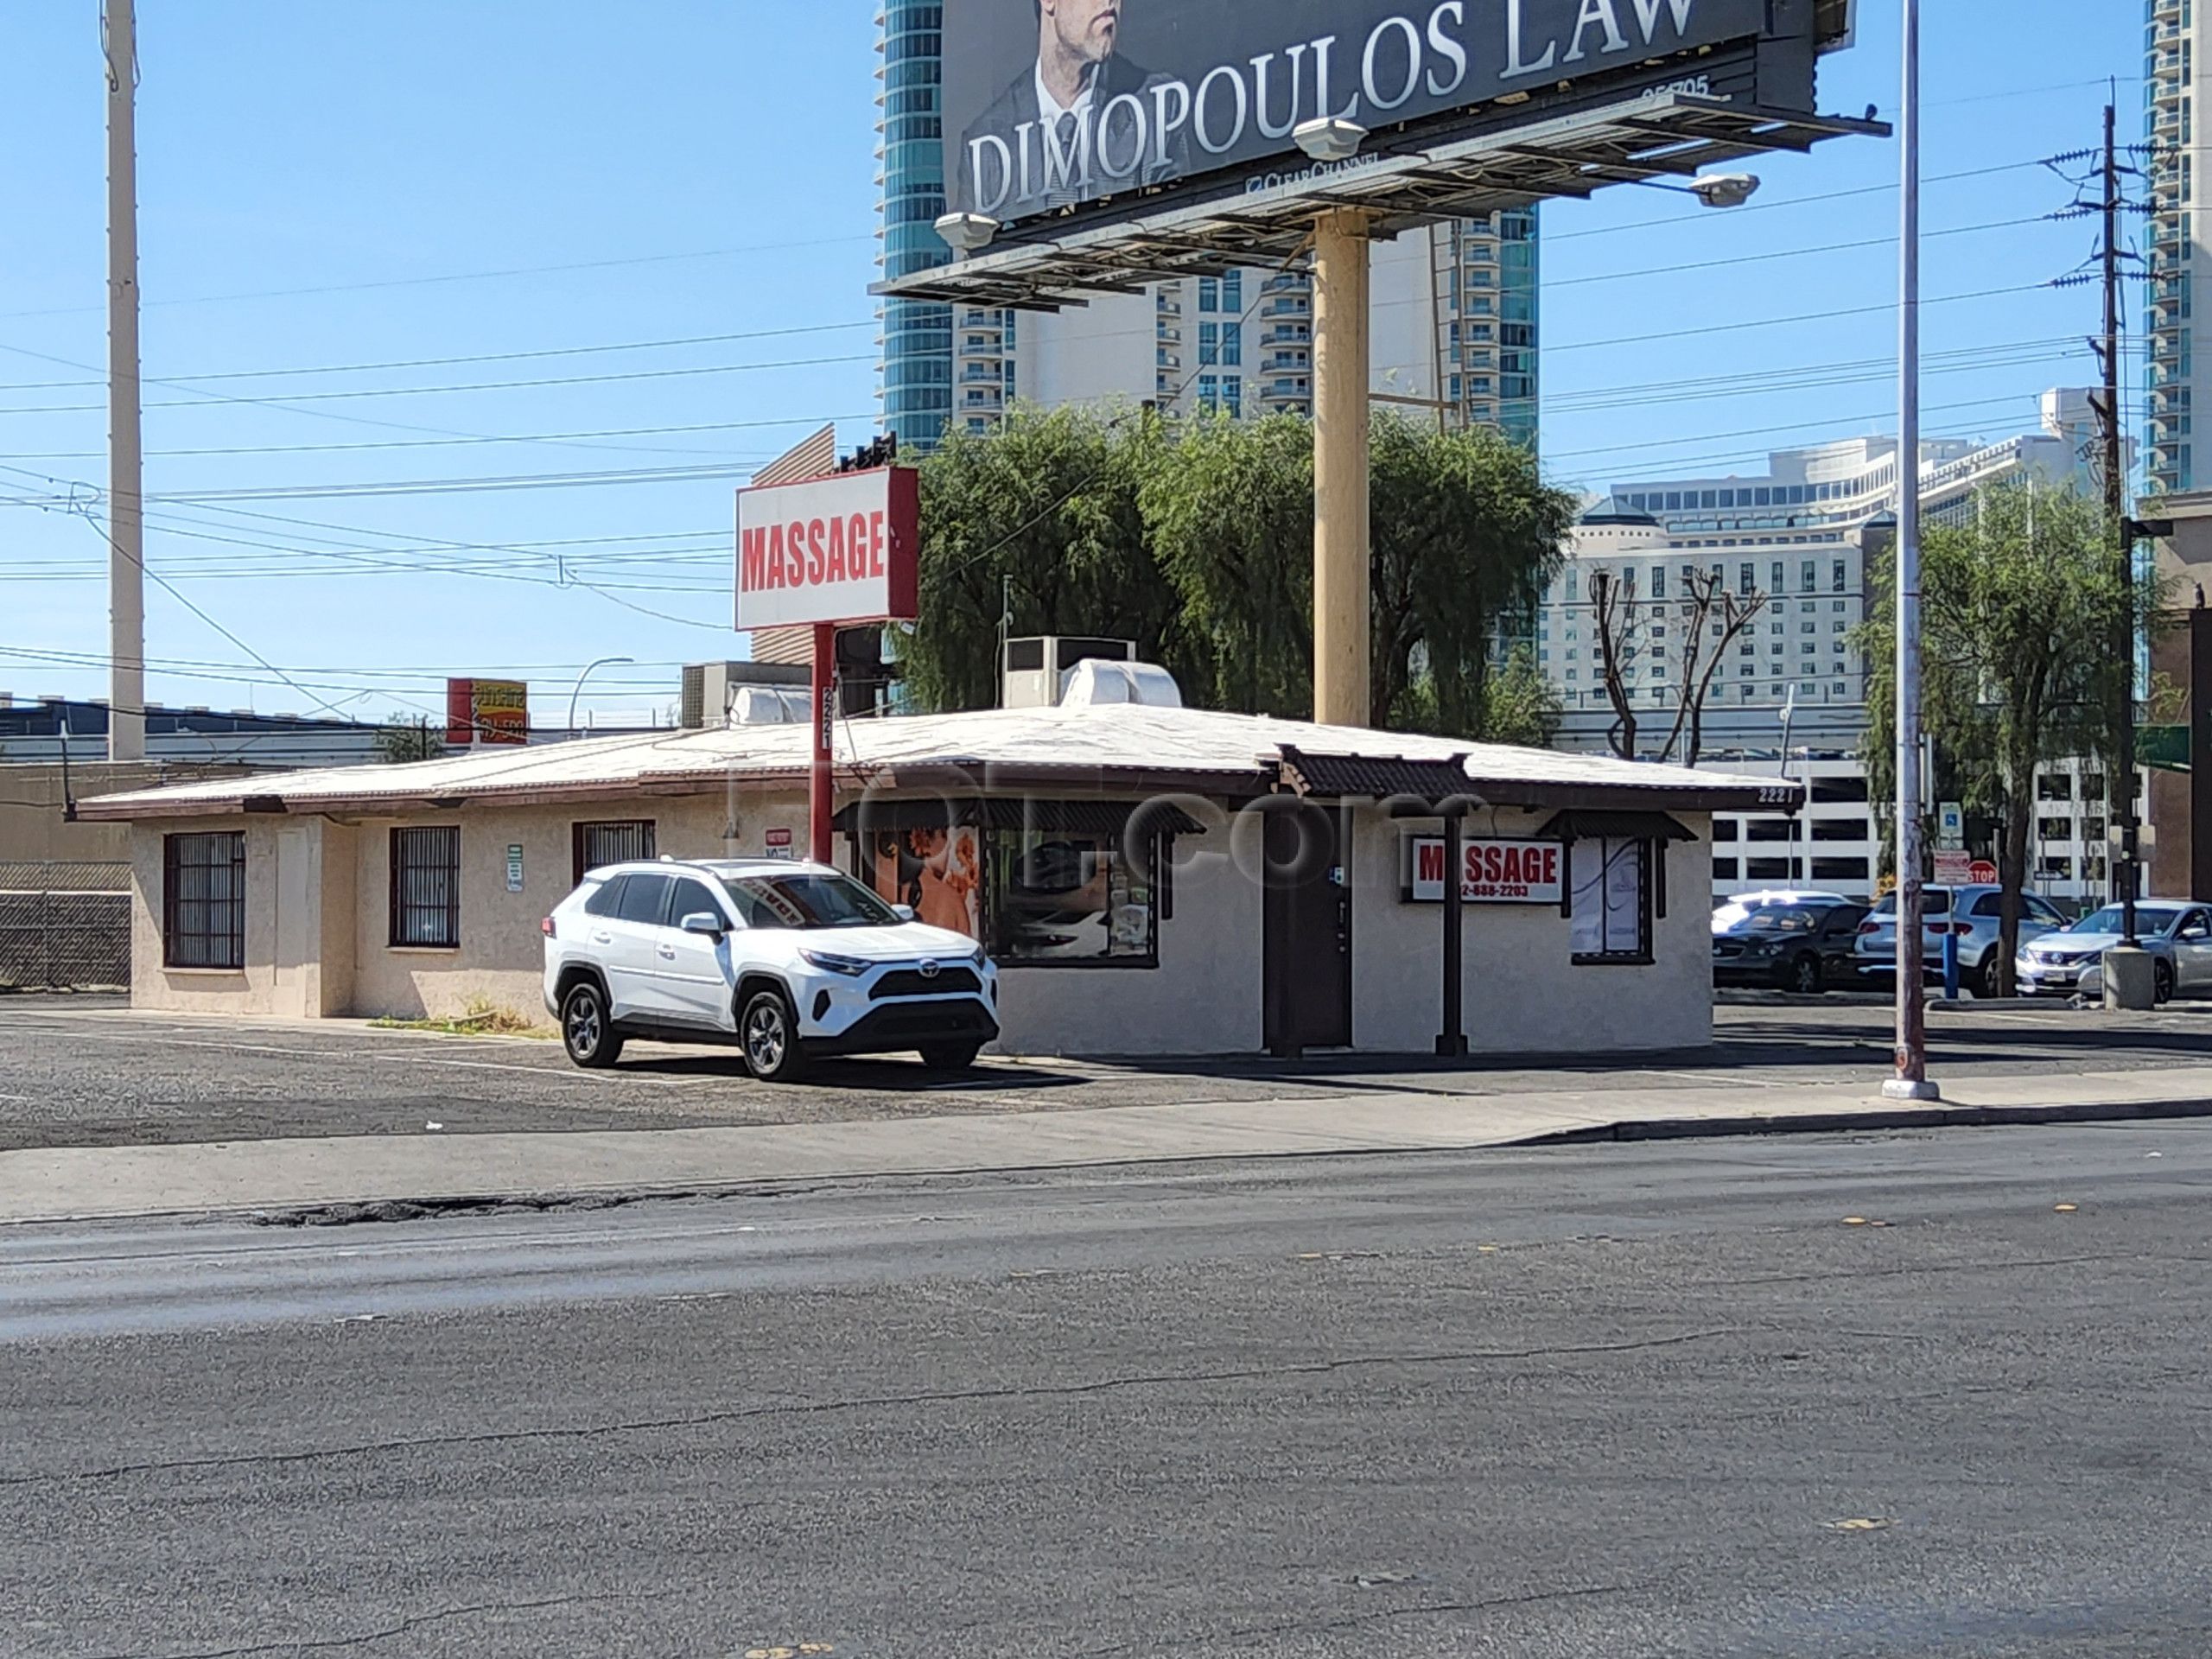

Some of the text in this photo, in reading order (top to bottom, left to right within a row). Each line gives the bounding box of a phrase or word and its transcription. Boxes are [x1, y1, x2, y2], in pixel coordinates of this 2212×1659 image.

[969, 0, 1694, 213] DIMOPOULOS LAW
[741, 511, 884, 593] MASSAGE
[823, 688, 832, 748] 2221
[1758, 787, 1793, 804] 2221
[1419, 844, 1557, 884] MSSAGE
[1967, 870, 1995, 882] STOP
